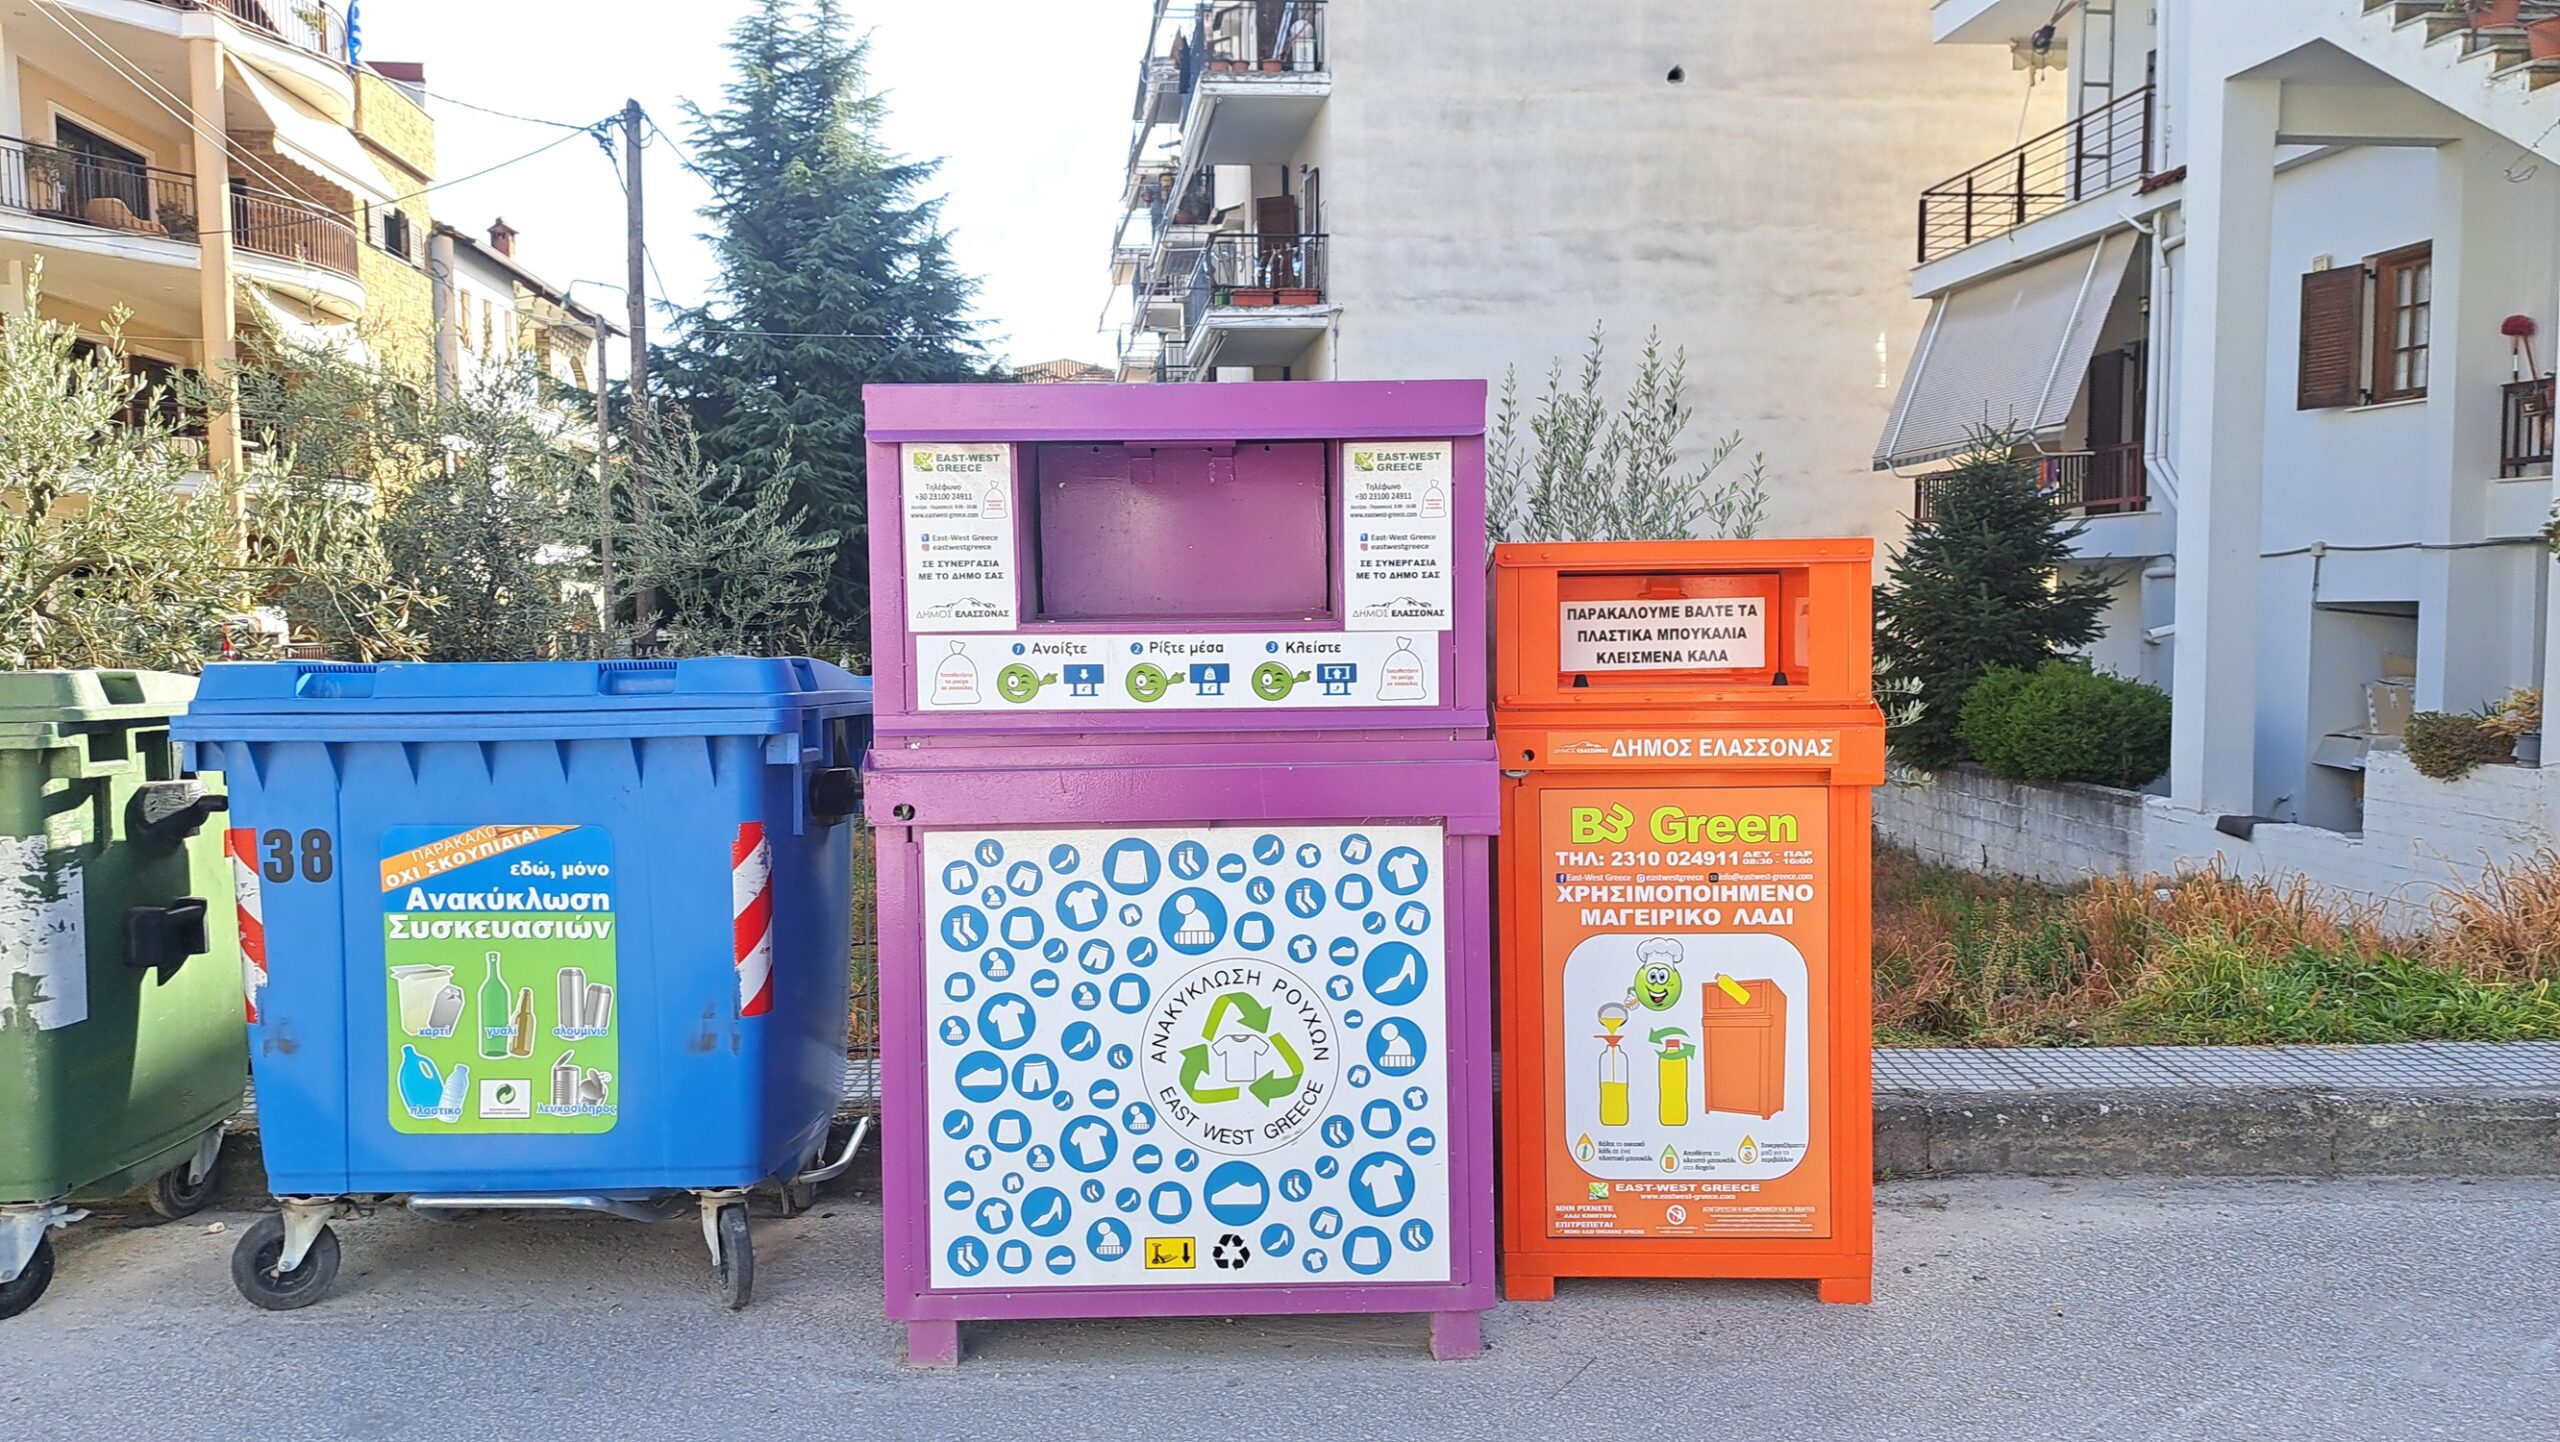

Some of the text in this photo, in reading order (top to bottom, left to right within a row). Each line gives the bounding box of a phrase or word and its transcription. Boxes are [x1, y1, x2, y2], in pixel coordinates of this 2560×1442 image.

[936, 453, 1000, 462] EAST-WEST
[1377, 452, 1441, 461] EAST-WEST
[936, 463, 982, 472] GREECE
[1377, 462, 1423, 471] GREECE
[952, 492, 973, 500] 24911
[1391, 492, 1412, 500] 24911
[1371, 533, 1436, 541] East-West Greece
[932, 543, 992, 552] eastwestgreece
[1371, 543, 1430, 551] eastwestgreece
[922, 560, 1000, 568] ΣΕ ΣΥΝΕΡΓΑΣΙΑ
[1360, 559, 1437, 567] ΣΕ ΣΥΝΕΡΓΑΣΙΑ
[918, 572, 1004, 580] ΜΕ ΤΟ ΔΗΜΟ ΣΑΣ
[1356, 571, 1440, 580] ΜΕ ΤΟ ΔΗΜΟ ΣΑΣ
[916, 610, 1009, 618] ΔΗΜΟΣ ΕΛΑΣΣΟΝΑΣ
[1352, 609, 1445, 618] ΔΗΜΟΣ ΕΛΑΣΣΟΝΑΣ
[1566, 603, 1758, 621] ΠΑΡΑΚΑΛΟΥΜΕ ΒΑΛΤΕ ΤΑ
[1577, 626, 1747, 643] ΠΛΑΣΤΙΚΑ ΜΠΟΥΚΑΛΙΑ
[1032, 642, 1088, 655] Ανοίξτε
[1149, 642, 1185, 655] Ρίξτε
[1190, 641, 1224, 656] μέσα
[1286, 641, 1341, 653] Κλείστε
[1596, 649, 1728, 665] ΚΛΕΙΣΜΕΝΑ ΚΑΛΑ
[1612, 738, 1833, 757] ΔΗΜΟΣ ΕΛΑΣΣΟΝΑΣ
[1649, 805, 1799, 844] Green
[411, 825, 498, 863] ΠΑΡΑΚΑΛΩ
[263, 828, 334, 884] 38
[385, 826, 542, 889] ΟΧΙ ΣΚΟΥΠΙΔΙΑ!
[1555, 850, 1739, 867] ΤΗΛ: 2310 024911
[510, 860, 610, 880] εδώ, μόνο
[1567, 874, 1632, 882] East-West Greece
[1646, 874, 1705, 883] eastwestgreece
[405, 886, 611, 913] Ανακύκλωση
[1556, 884, 1814, 903] ΧΡΗΣΙΜΟΠΟΙΗΜΕΝΟ
[1581, 908, 1794, 926] ΜΑΓΕΙΡΙΚΟ ΛΑΔΙ
[388, 914, 612, 940] Συσκευασιών
[1151, 968, 1329, 1064] ΑΝΑΚΥΚΛΩΣΗ ΡΟΥΧΩΝ
[419, 1027, 450, 1039] χαρτί
[1159, 1080, 1324, 1145] EAST WEST GREECE
[1615, 1183, 1761, 1192] EAST-WEST GREECE
[1577, 1204, 1615, 1212] ΡΙΧΝΕΤΕ
